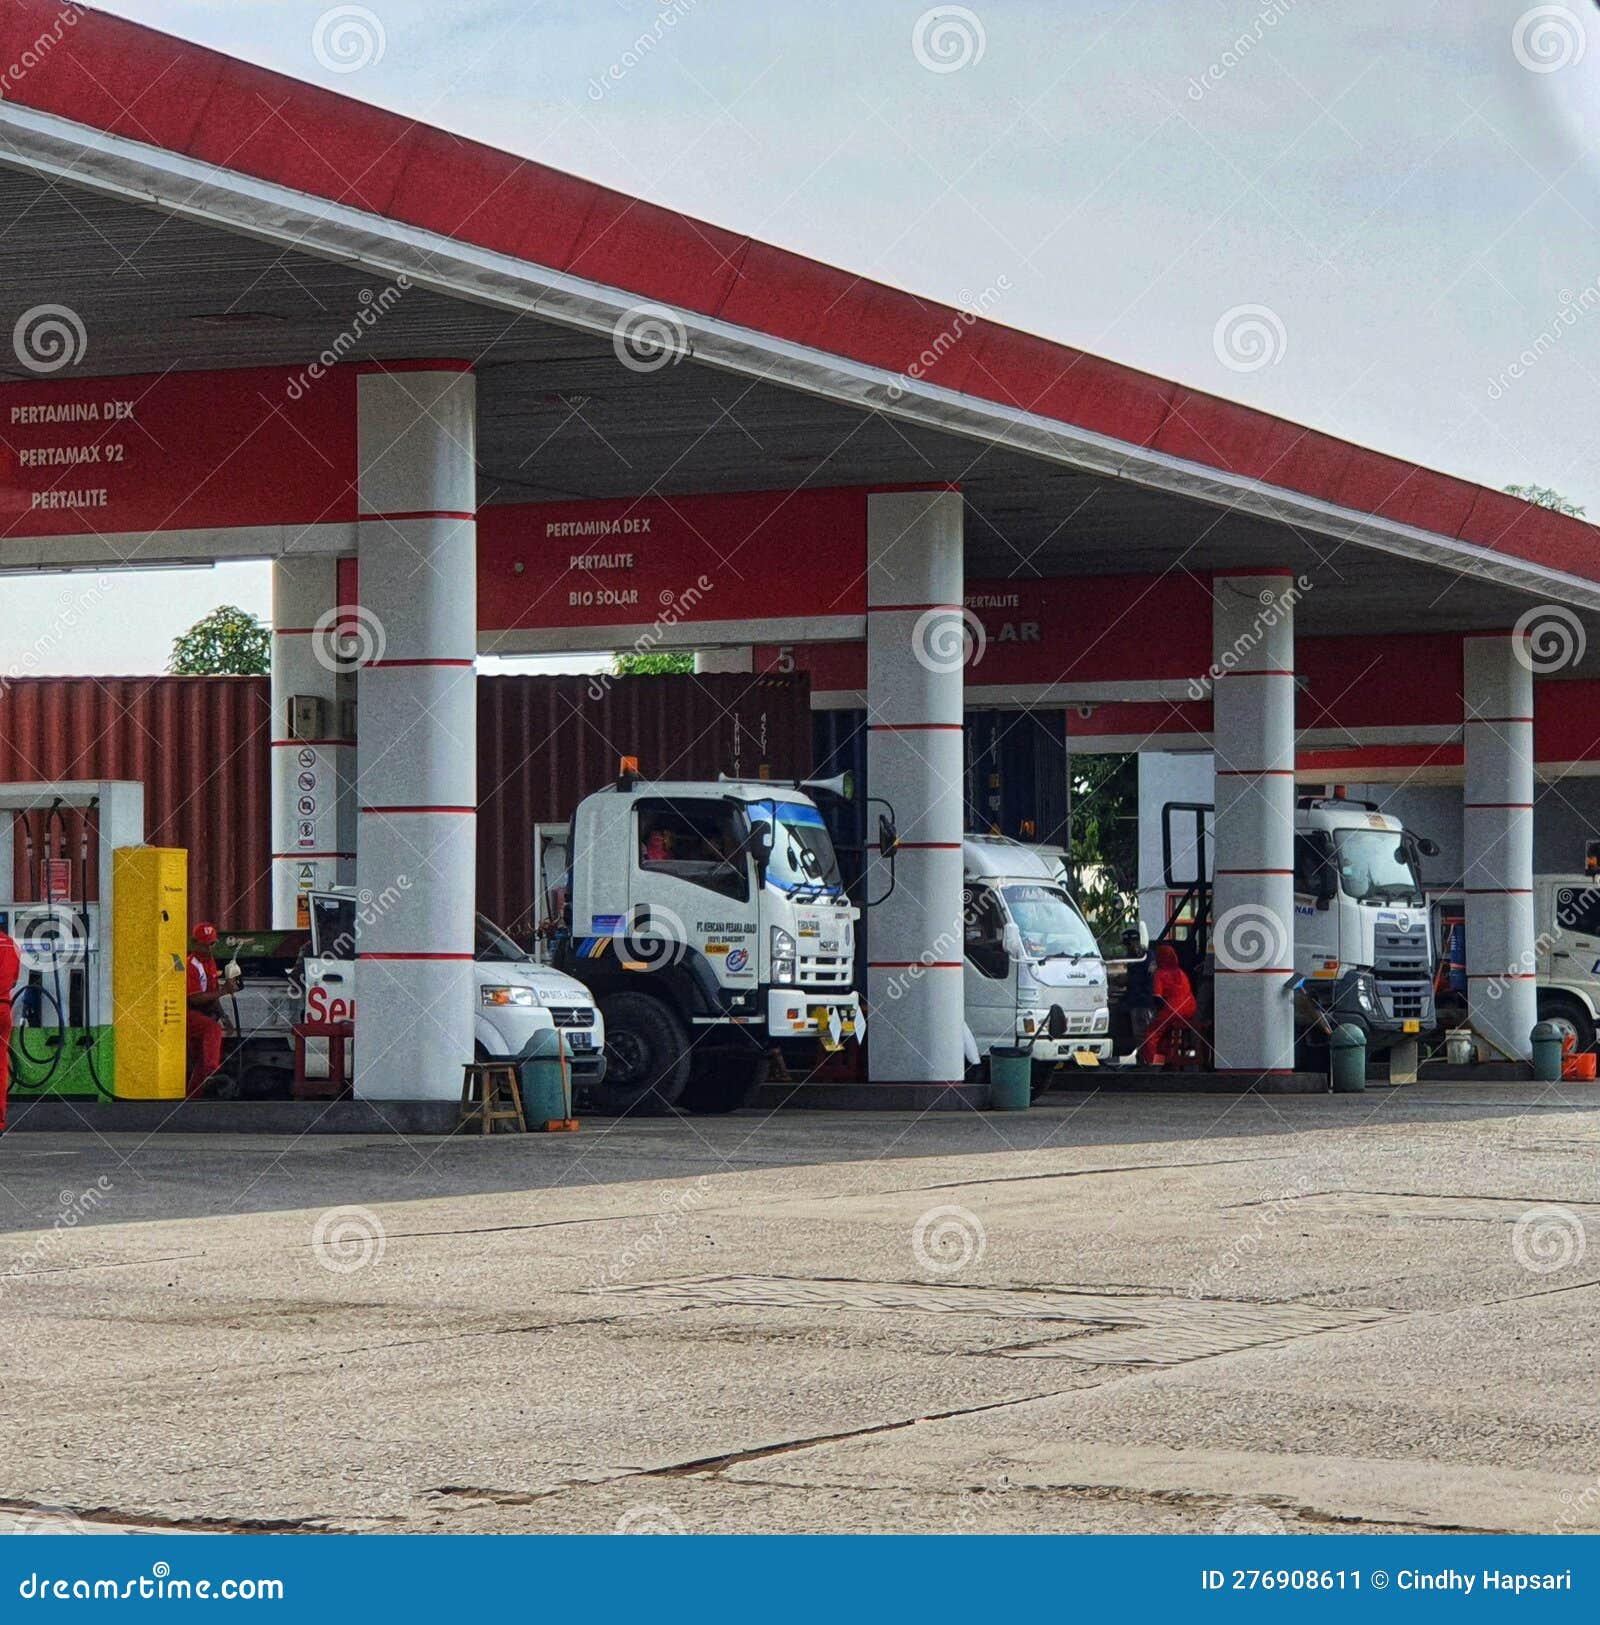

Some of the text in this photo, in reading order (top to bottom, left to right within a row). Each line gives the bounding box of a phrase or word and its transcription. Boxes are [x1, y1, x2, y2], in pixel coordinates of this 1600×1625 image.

[11, 401, 134, 424] PERTAMINA DEX
[20, 444, 124, 467] PERTAMAX 92
[32, 489, 107, 509] PERTALITE
[546, 518, 651, 537] PERTAMINA DEX
[570, 553, 633, 569] PERTALITE
[569, 590, 638, 606] BIO SOLAR
[964, 594, 1019, 608] PERTALITE
[779, 646, 794, 673] 5
